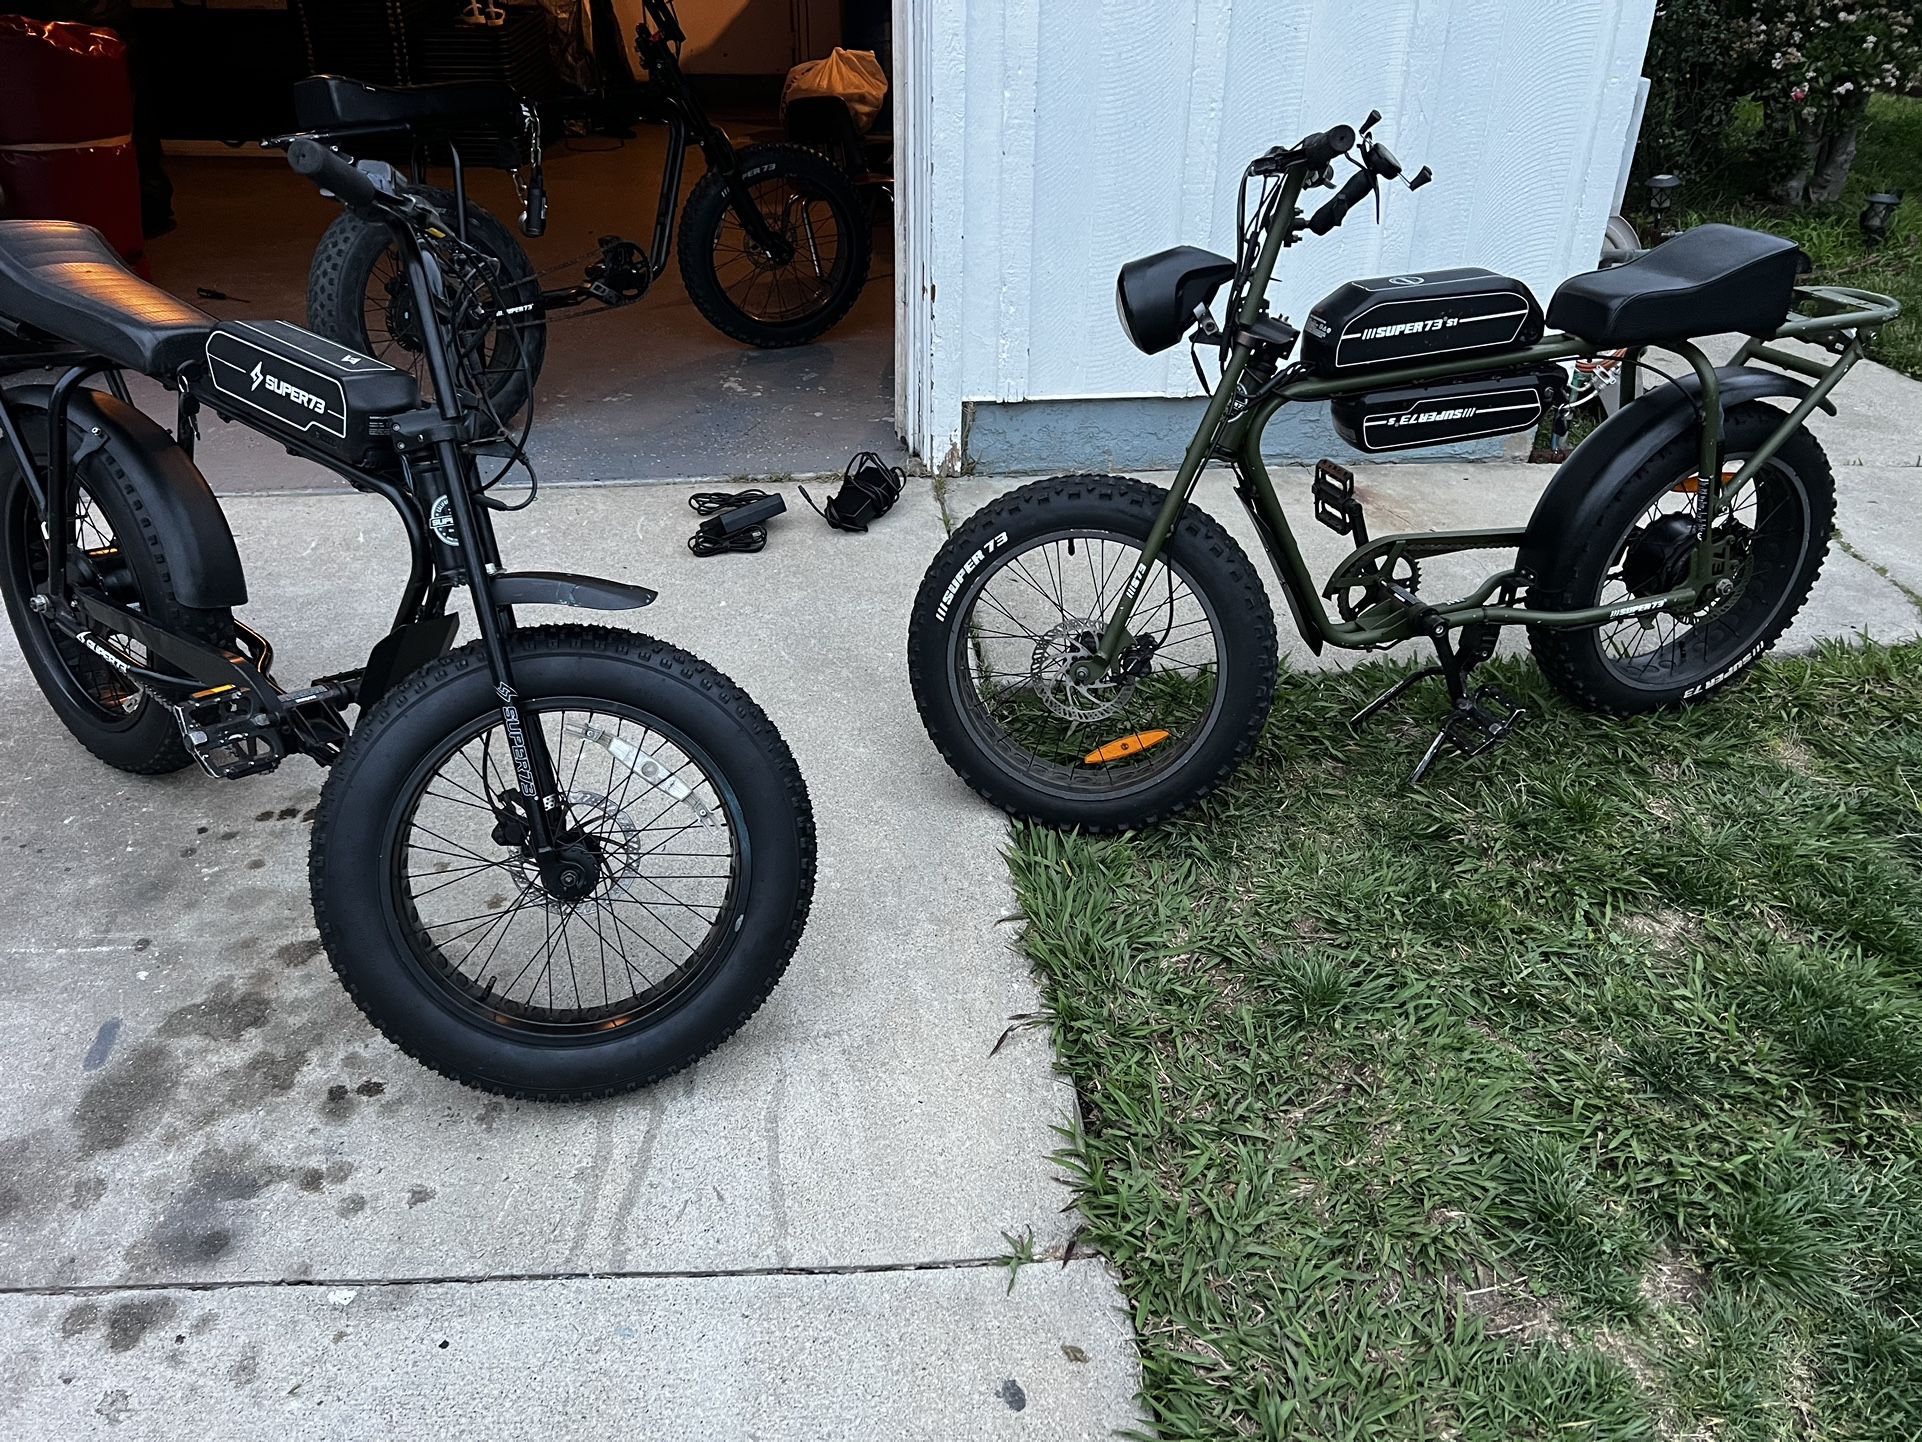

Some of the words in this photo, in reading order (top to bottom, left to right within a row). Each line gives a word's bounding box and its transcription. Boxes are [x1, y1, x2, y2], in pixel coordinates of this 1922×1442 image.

[265, 374, 326, 414] SUPER73
[942, 549, 985, 606] SUPER
[983, 531, 1009, 553] 73
[1705, 652, 1753, 690] SUPER
[1683, 684, 1704, 699] 73
[503, 706, 537, 797] SUPER73
